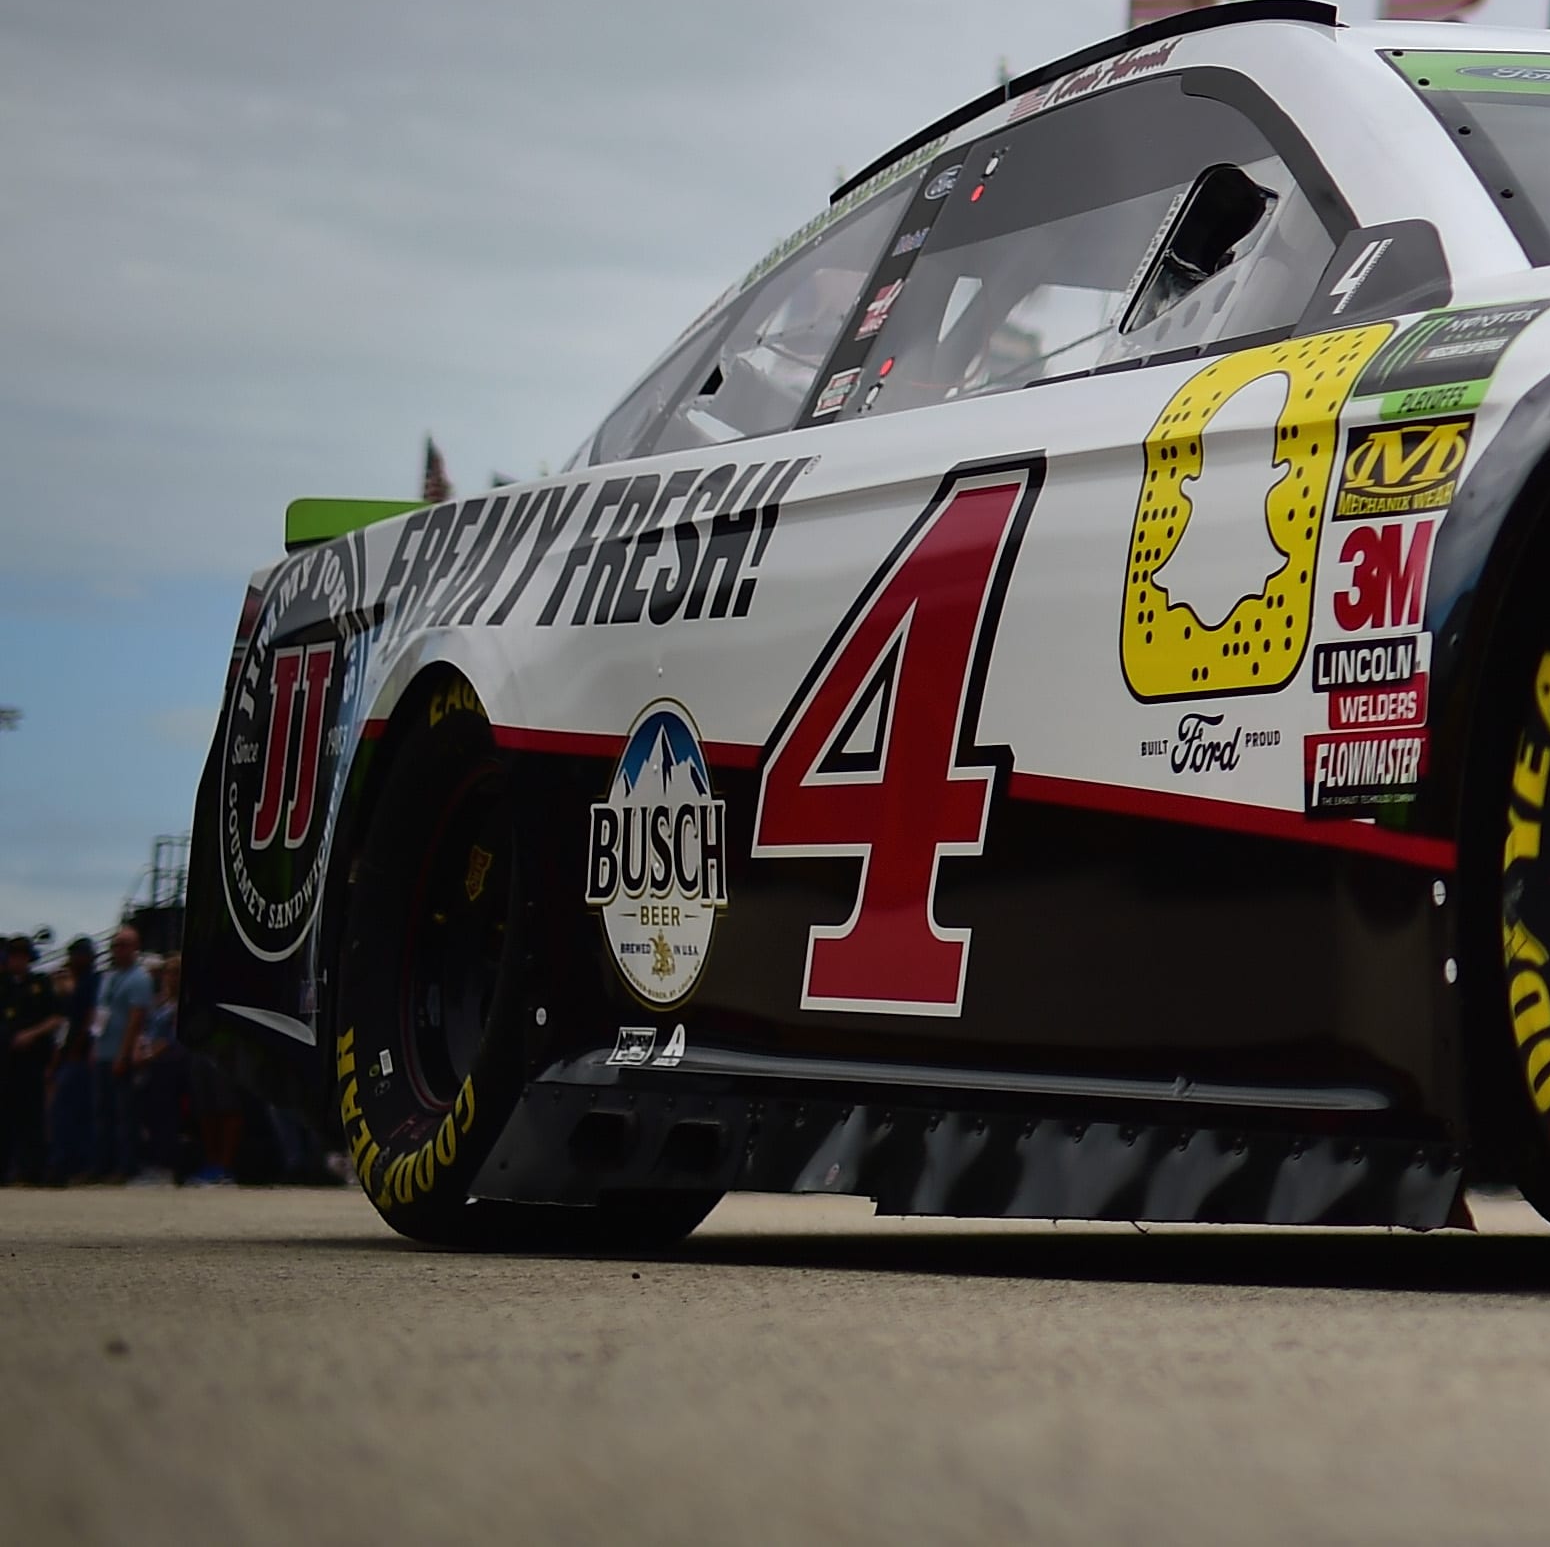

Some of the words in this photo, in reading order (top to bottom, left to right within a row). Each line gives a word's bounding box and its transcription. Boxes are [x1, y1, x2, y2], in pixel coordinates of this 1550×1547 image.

[1329, 238, 1394, 315] 4
[1398, 385, 1469, 414] PLAYOFFS
[1337, 495, 1411, 517] MECHANIX
[1412, 480, 1455, 511] WEAR
[535, 456, 814, 627] FRESH!
[1333, 520, 1434, 632] 3M
[1317, 644, 1414, 687] LINCOLN
[751, 450, 1046, 1017] 4
[1338, 690, 1418, 724] WELDERS
[1141, 739, 1169, 757] BUILT
[1170, 713, 1243, 774] Ford
[1245, 729, 1281, 748] PROUD
[1311, 737, 1423, 807] FLOWMASTER
[587, 803, 727, 904] BUSCH
[640, 905, 681, 926] BEER
[620, 942, 651, 955] BREWED
